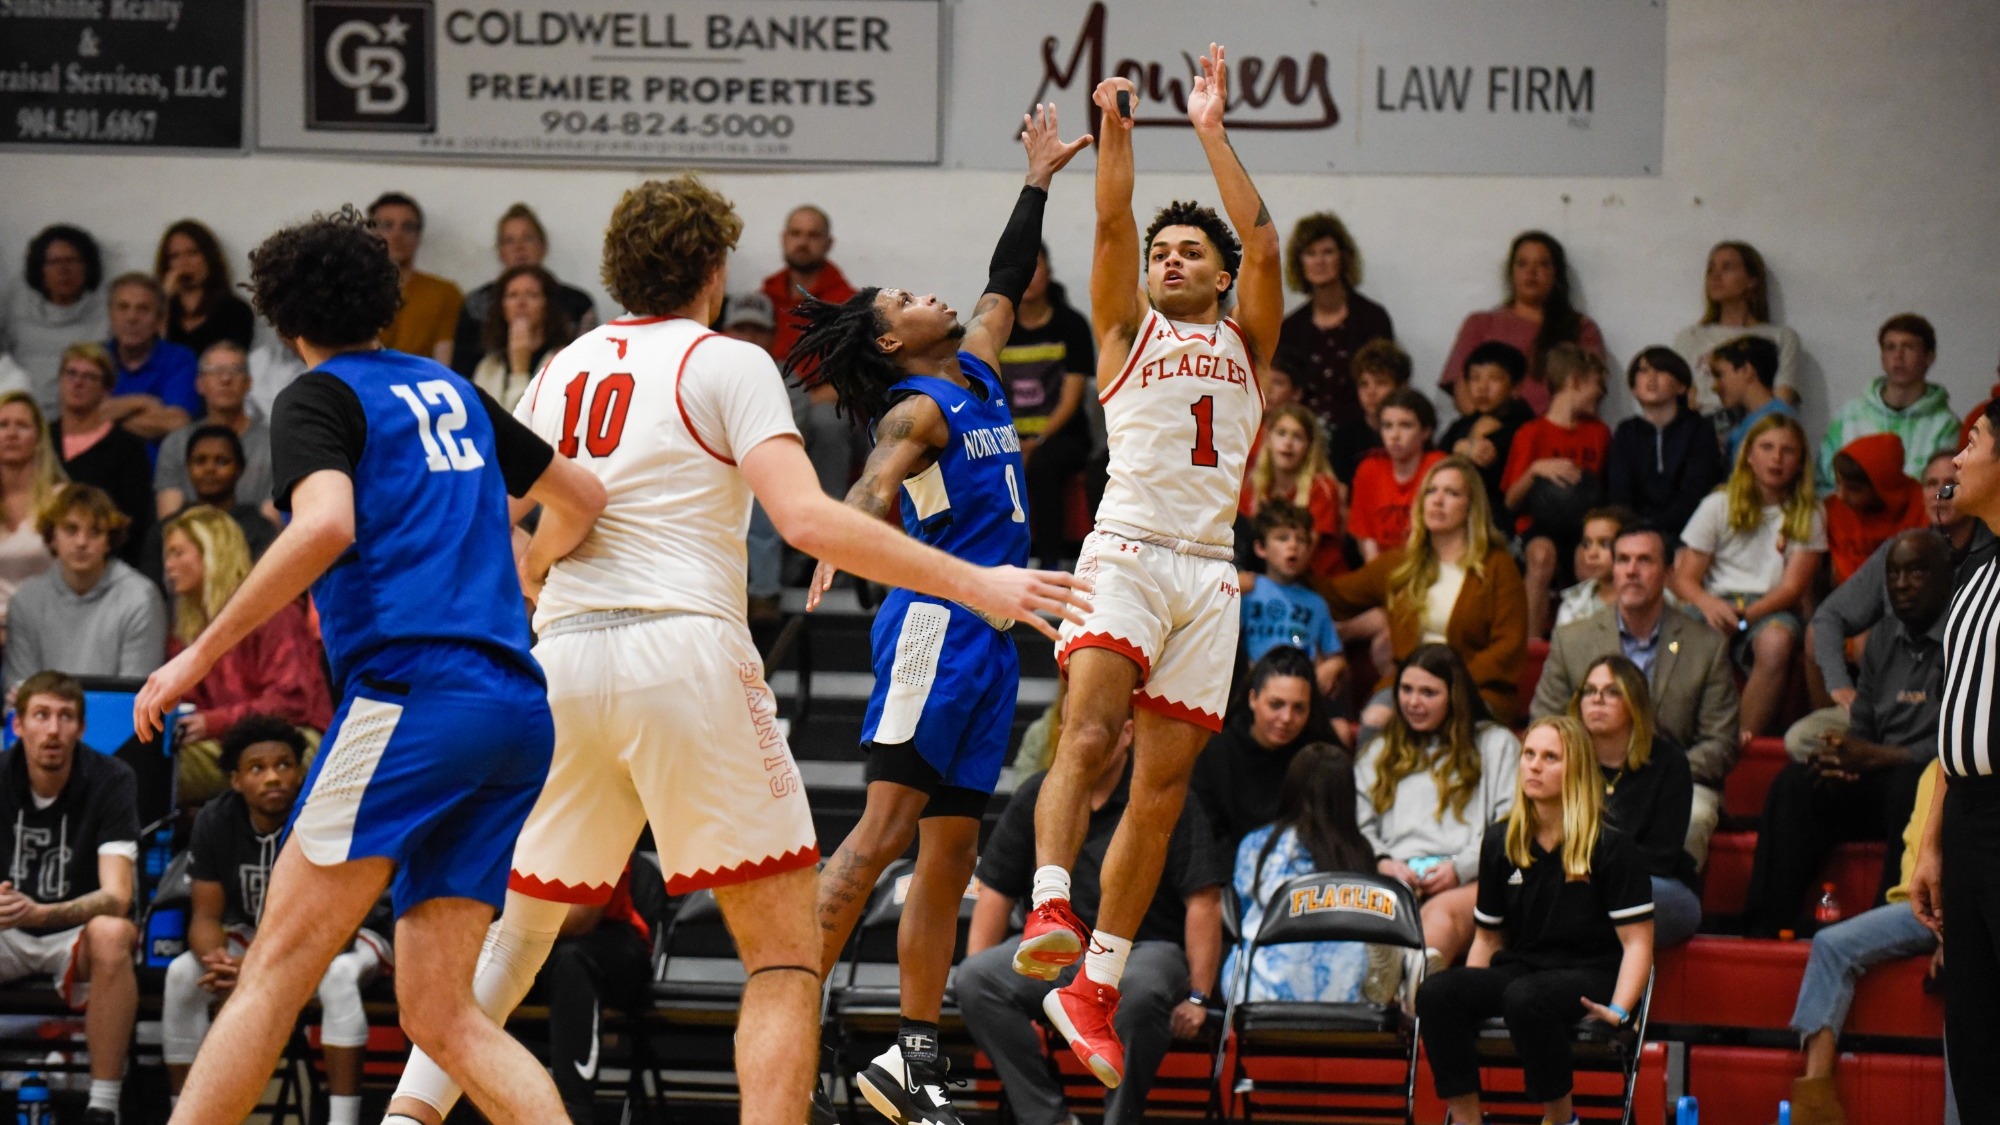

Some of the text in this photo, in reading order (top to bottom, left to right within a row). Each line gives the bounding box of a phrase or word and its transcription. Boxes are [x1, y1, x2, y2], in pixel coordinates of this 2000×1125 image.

[444, 10, 891, 53] COLDWELL BANKER
[66, 62, 169, 102] Services,
[174, 65, 228, 98] LLC
[467, 73, 877, 106] PREMIER PROPERTIES
[1376, 66, 1595, 113] LAW FIRM
[540, 110, 796, 139] 904-824-5000
[1141, 353, 1249, 395] FLAGLER
[389, 379, 485, 472] 12
[558, 371, 636, 459] 10
[1190, 394, 1218, 468] 1
[962, 428, 1001, 460] NORTH
[1004, 463, 1026, 523] 0
[739, 661, 798, 799] SAINTS
[1290, 884, 1397, 920] FLAGLER
